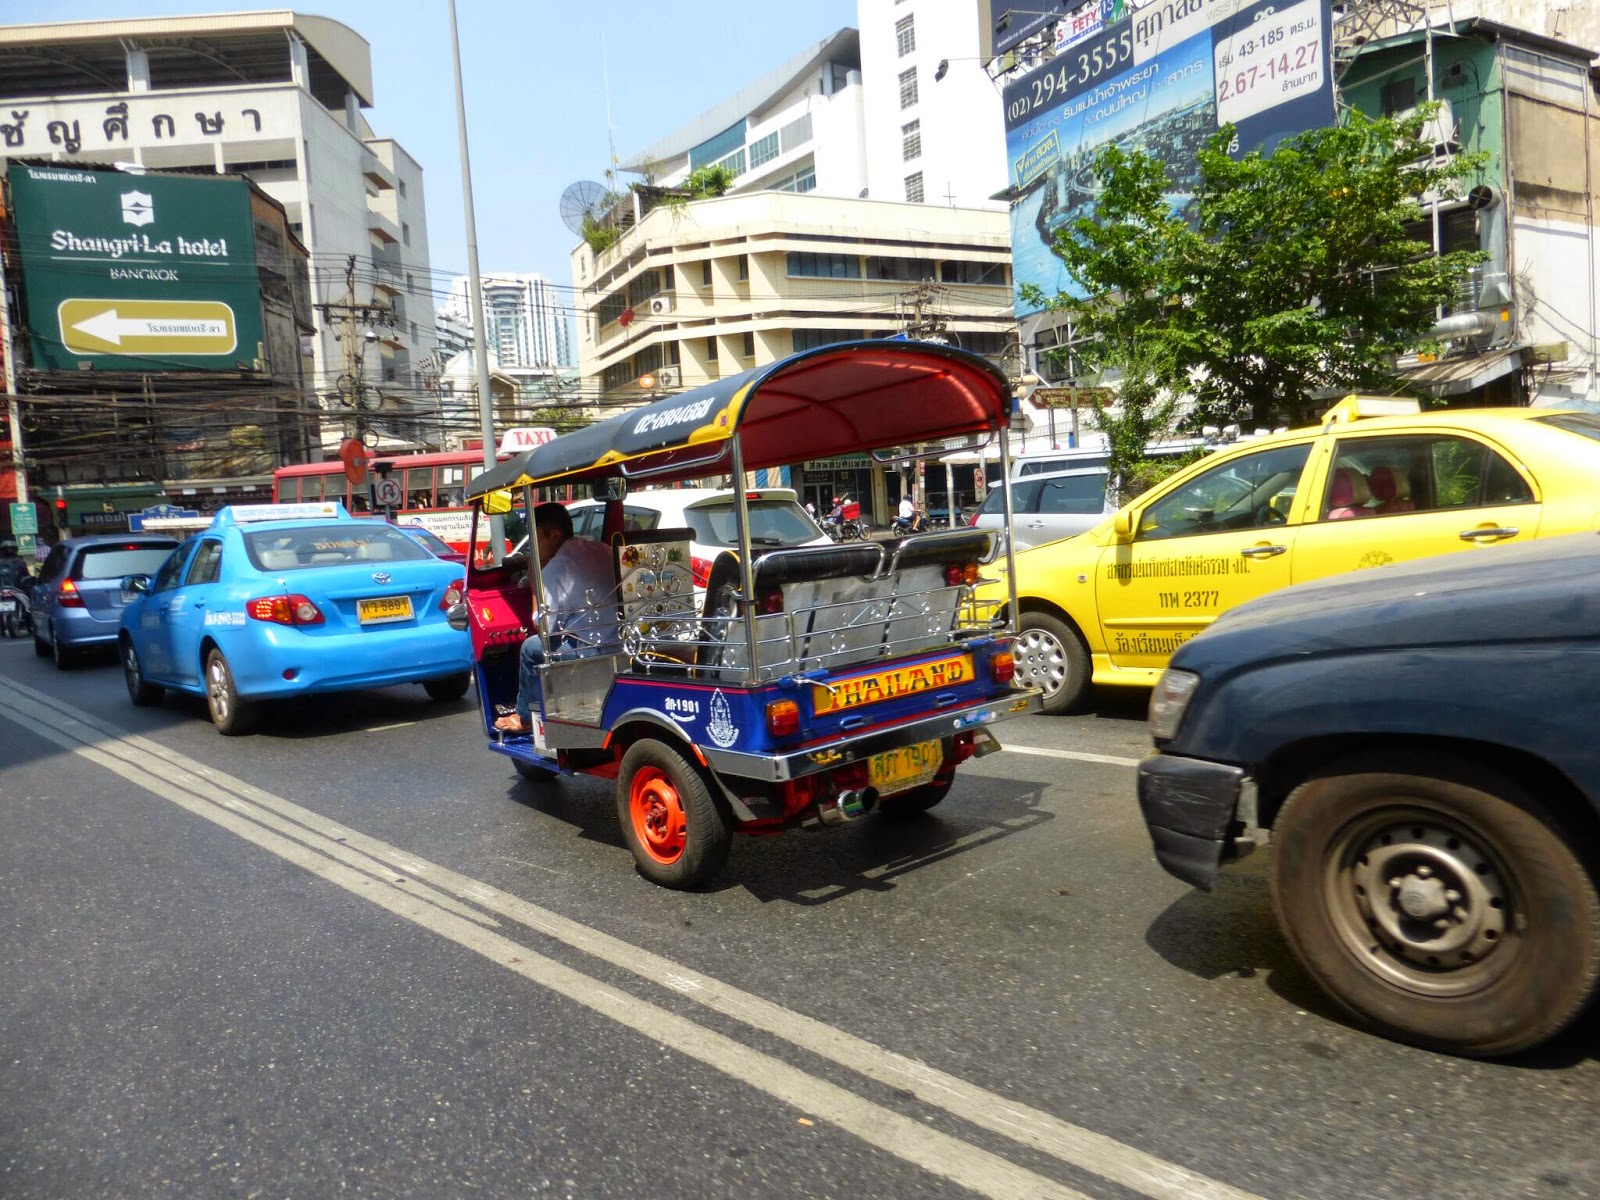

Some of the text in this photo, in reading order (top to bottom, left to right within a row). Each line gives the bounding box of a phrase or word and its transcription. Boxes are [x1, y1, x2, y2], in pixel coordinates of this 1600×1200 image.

[1239, 26, 1284, 58] 43-185
[1290, 16, 1317, 35] ตร.ม.
[1008, 30, 1131, 122] (02) 294-3555
[1219, 40, 1319, 102] 2.67-14.27
[1282, 71, 1318, 92] ล้านบาท
[50, 229, 229, 258] Shangri-La hotel
[110, 268, 179, 281] BANGKOK
[513, 431, 551, 446] TAXI
[1184, 590, 1219, 607] 2377
[827, 660, 963, 708] THAILAND
